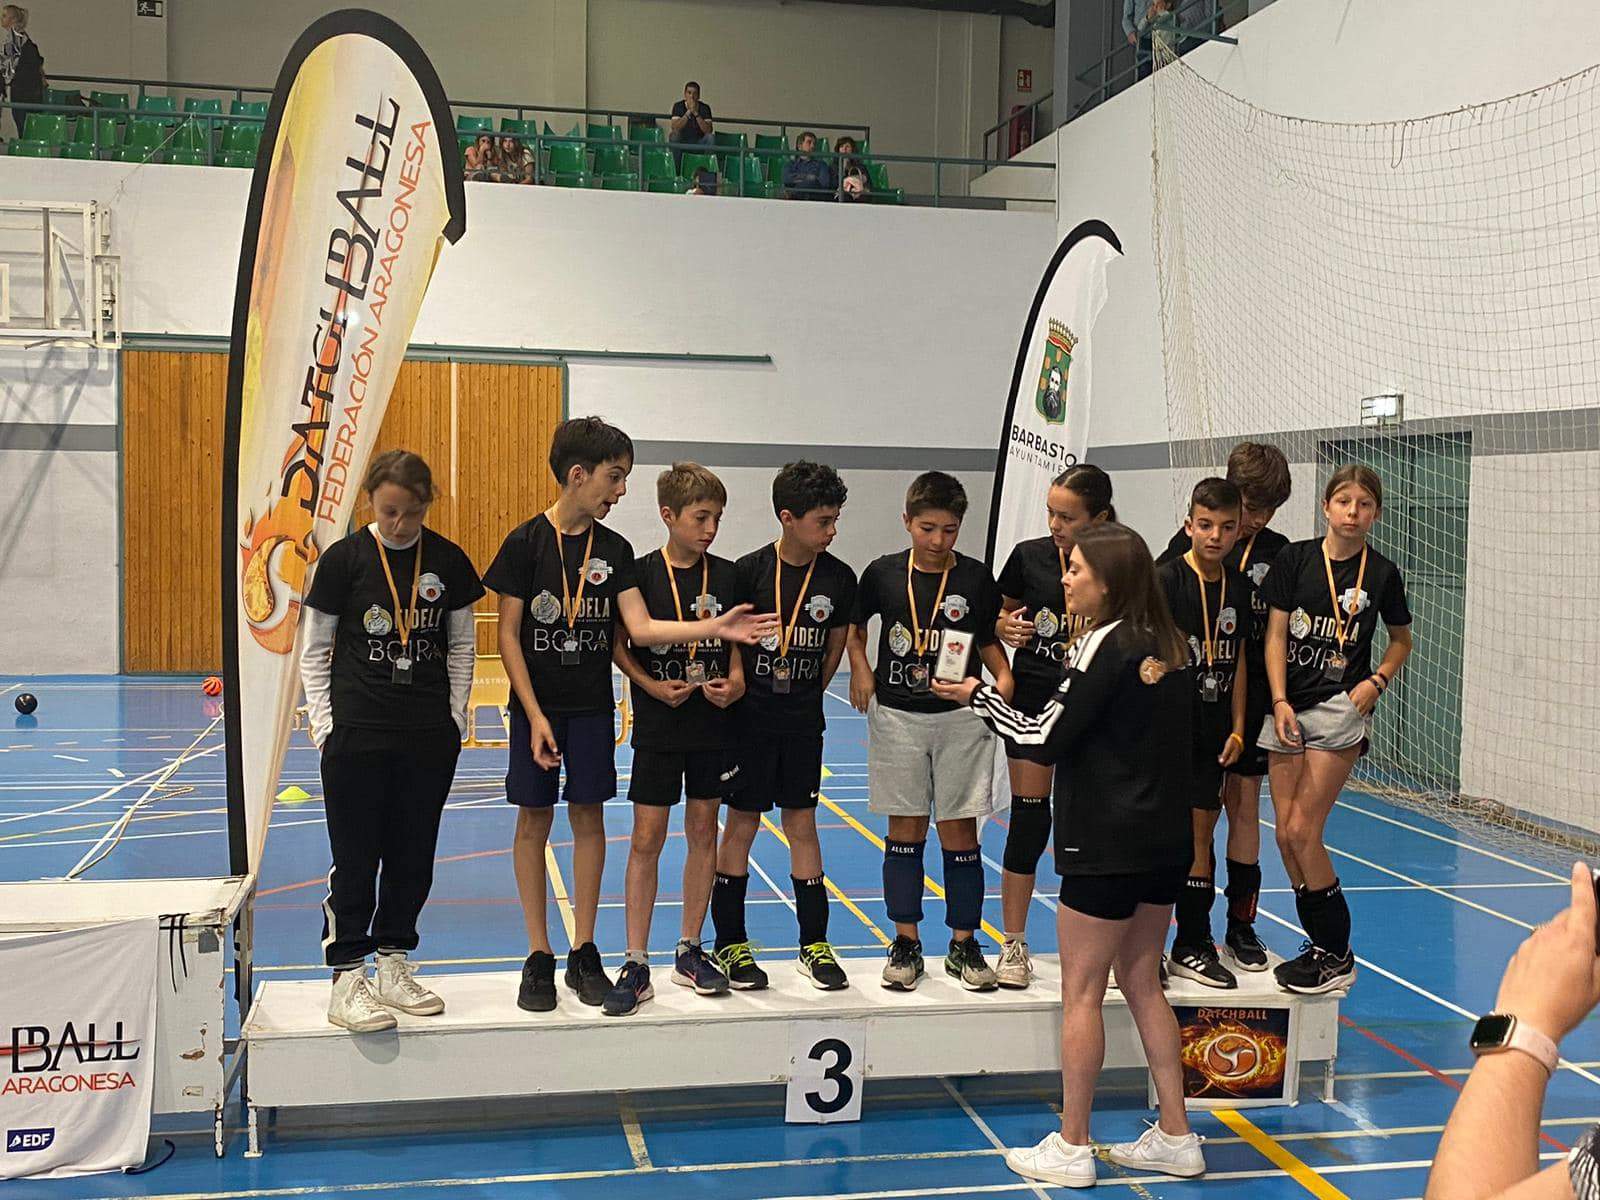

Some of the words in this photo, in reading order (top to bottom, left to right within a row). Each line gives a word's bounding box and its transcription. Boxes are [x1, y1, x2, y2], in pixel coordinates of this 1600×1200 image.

[316, 326, 379, 524] FEDERACIÓN
[368, 120, 432, 326] ARAGONESA
[1009, 445, 1066, 475] AYUNTAMIE
[1197, 1008, 1268, 1020] DATCHBALL
[1, 1071, 136, 1096] ARAGONESA
[804, 1038, 854, 1114] 3
[22, 1132, 51, 1147] EDF
